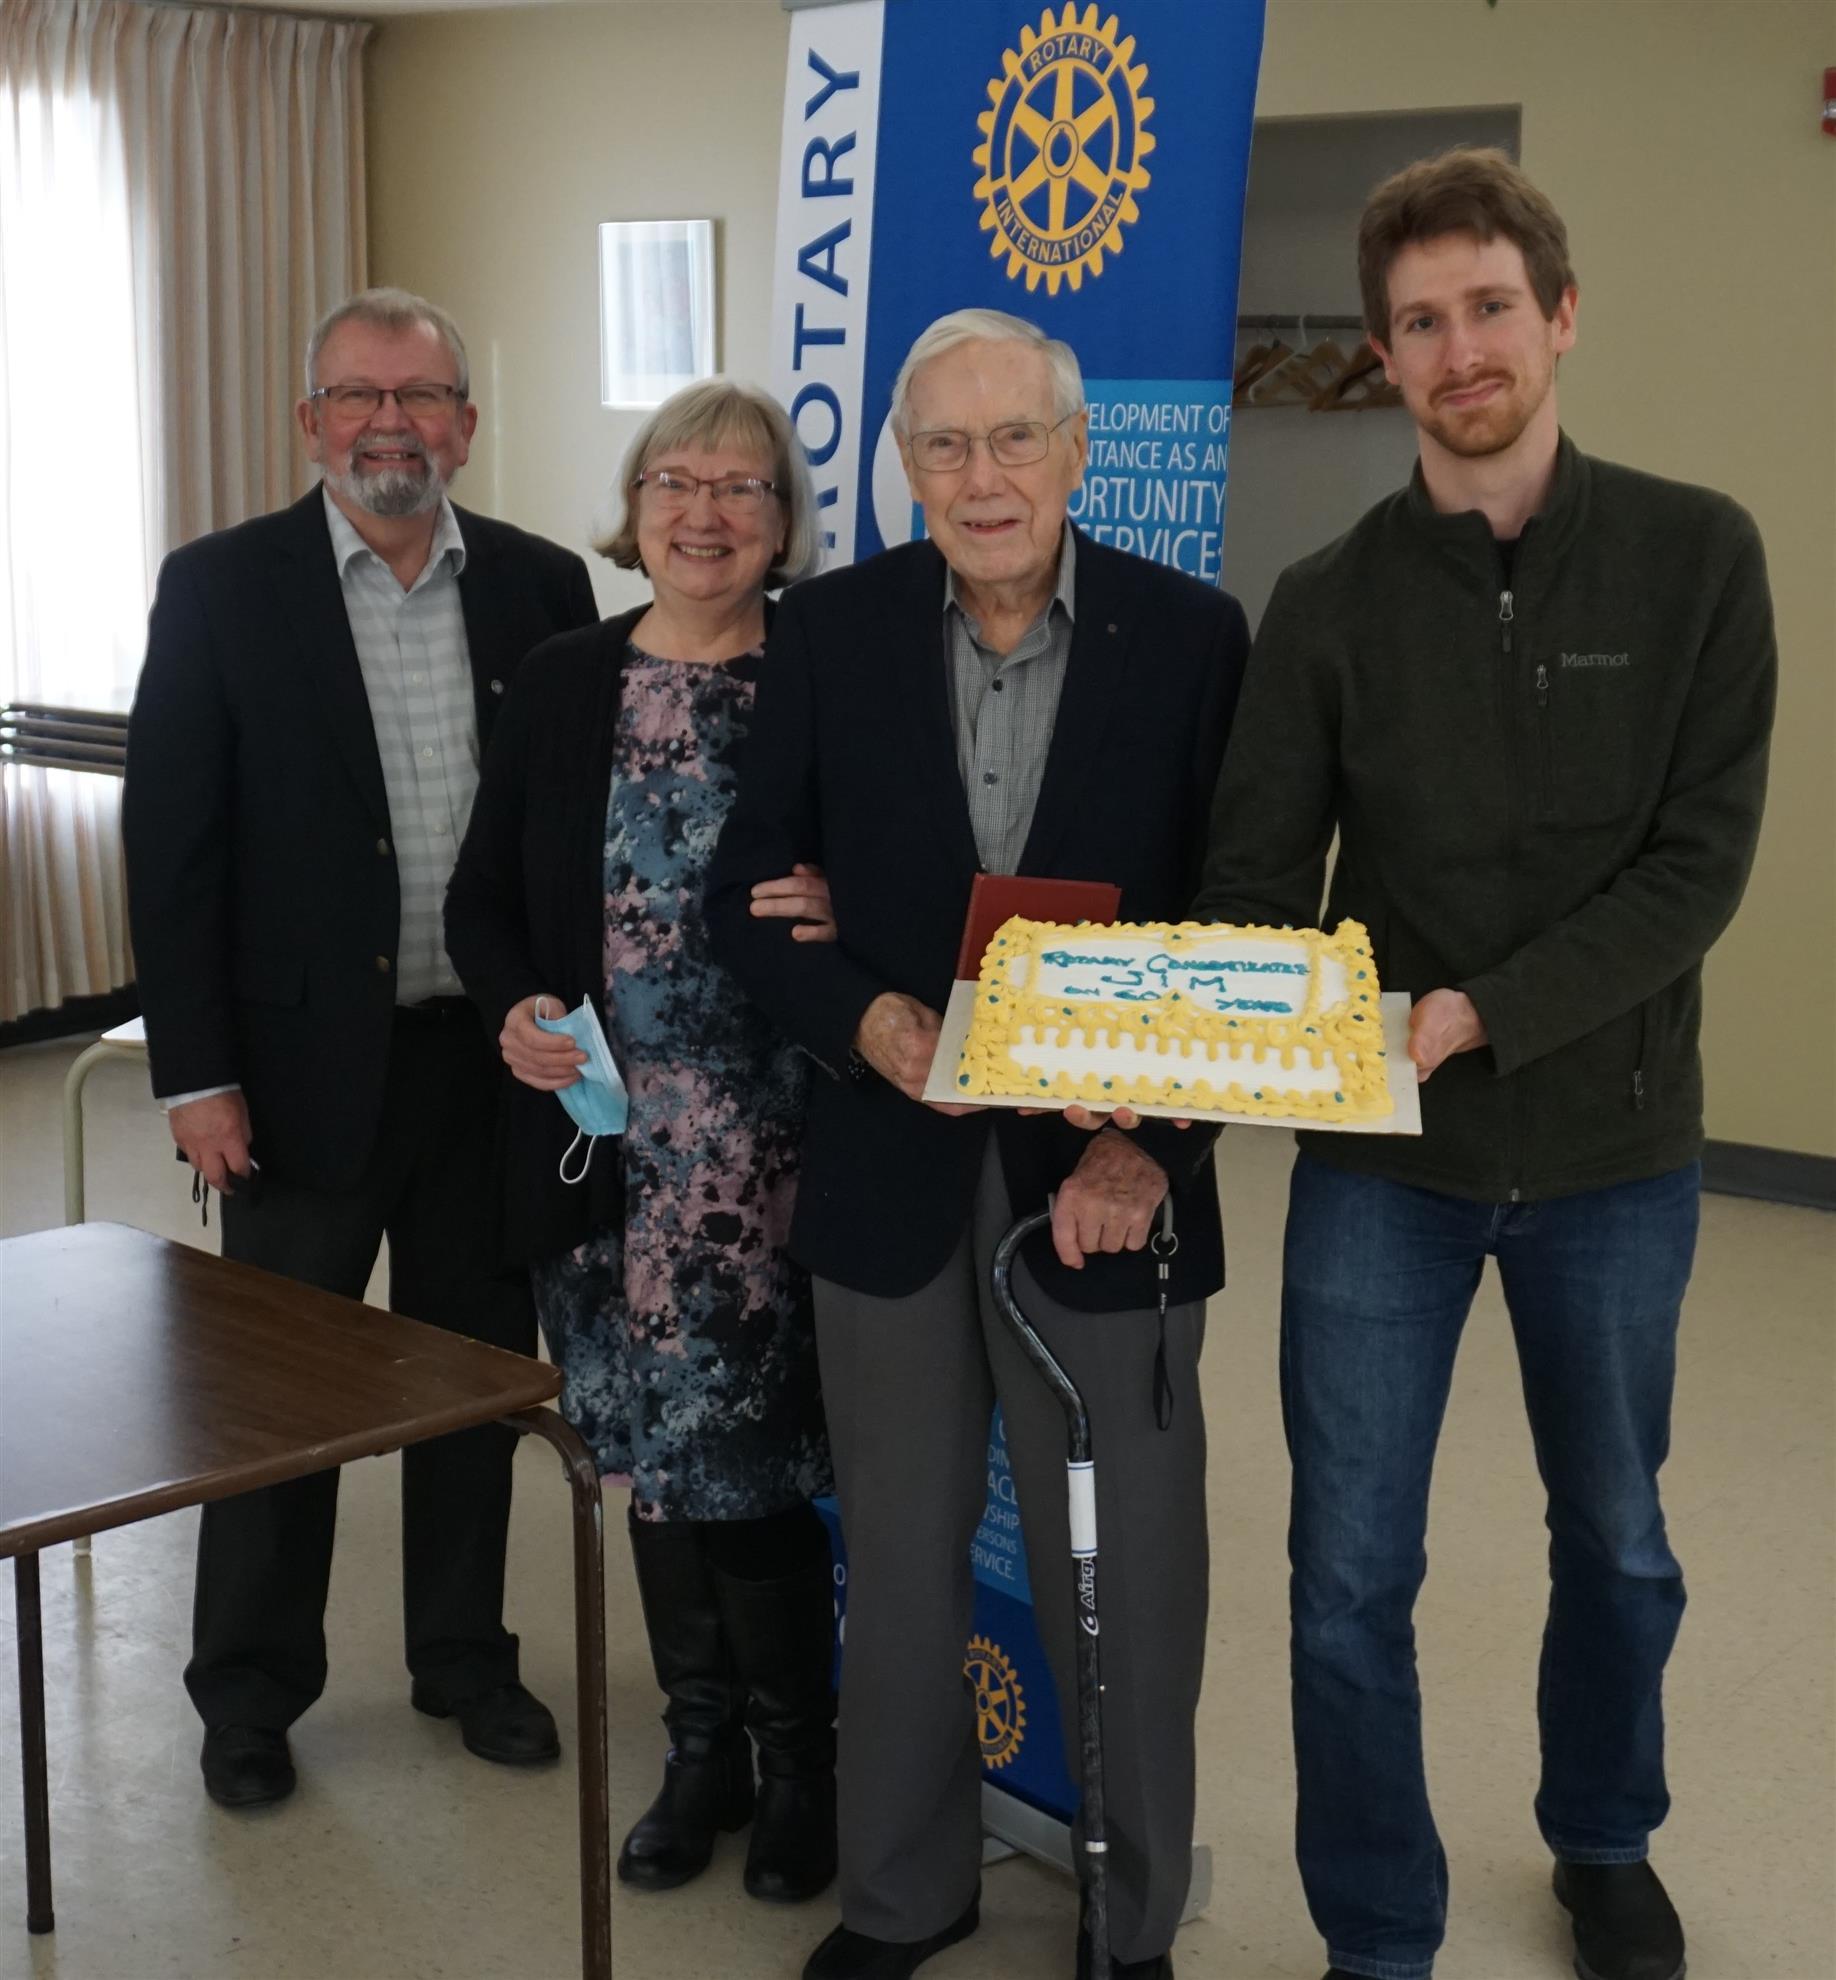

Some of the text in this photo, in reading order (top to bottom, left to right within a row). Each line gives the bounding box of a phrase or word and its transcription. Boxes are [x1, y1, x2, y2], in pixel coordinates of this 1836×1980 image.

[1029, 35, 1105, 73] ROTARY
[997, 191, 1123, 263] INTERNATIONAL
[790, 48, 860, 549] OTARY
[1084, 403, 1231, 433] ELOPMENT OF
[1167, 442, 1196, 471] AS
[1202, 443, 1228, 472] AN
[1561, 652, 1630, 668] Marmot
[983, 1504, 1020, 1530] SHIP
[1078, 1557, 1096, 1610] Airg
